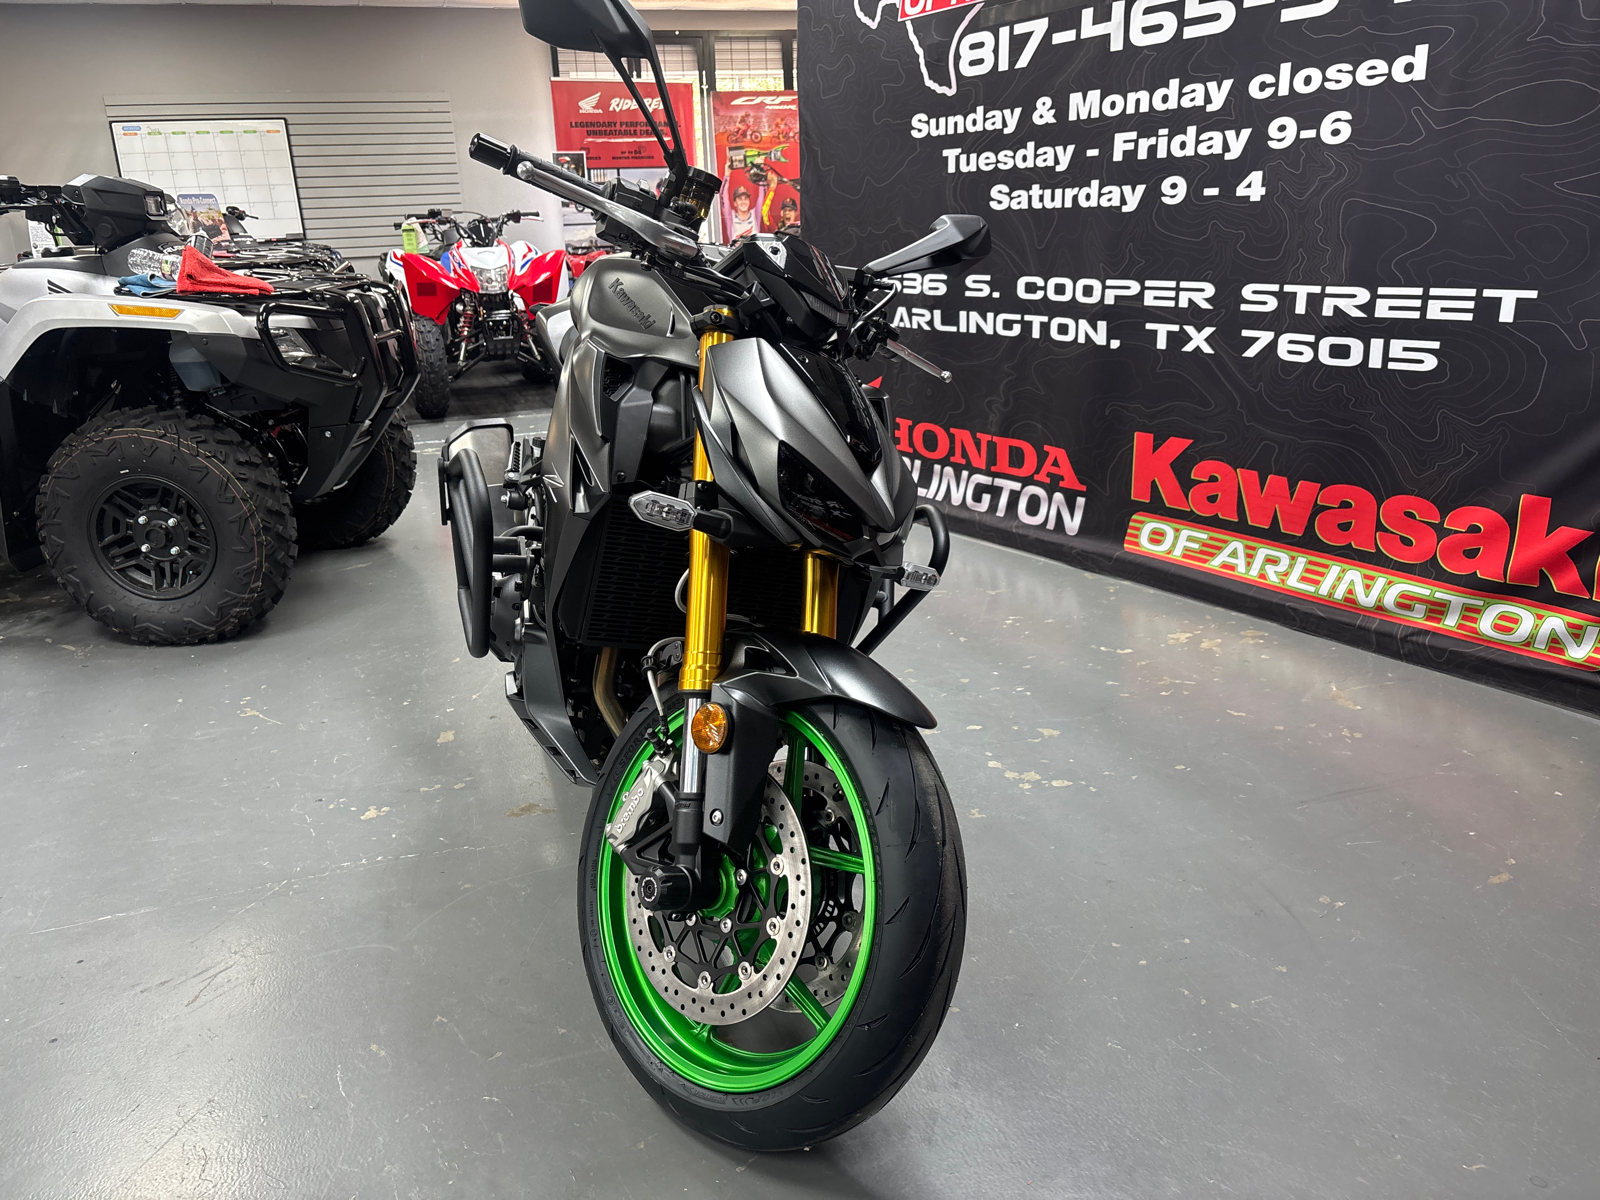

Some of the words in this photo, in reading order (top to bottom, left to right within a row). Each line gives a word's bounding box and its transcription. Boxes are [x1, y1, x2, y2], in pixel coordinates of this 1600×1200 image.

[730, 95, 798, 106] CRF
[911, 106, 1022, 138] Sunday
[1032, 96, 1057, 125] &
[1069, 78, 1234, 121] Monday
[1248, 44, 1429, 100] closed
[570, 121, 617, 129] LEGENDARY
[586, 129, 638, 137] UNBEATABLE
[640, 129, 668, 137] DEAS.
[942, 141, 1075, 173] Tuesday
[1113, 125, 1252, 162] Friday
[1267, 111, 1352, 149] 9-6
[989, 179, 1146, 212] Saturday
[1161, 176, 1187, 205] 9
[1236, 171, 1266, 201] 4
[608, 277, 656, 330] Kawasaki
[965, 275, 1000, 298] S.
[1017, 276, 1215, 309] COOPER
[1240, 284, 1538, 323] STREET
[893, 306, 1120, 349] ARLINGTON,
[1145, 322, 1216, 354] TX
[1240, 329, 1440, 372] 76015
[902, 456, 1086, 536] LINGTON
[1131, 431, 1600, 601] Kawasak
[1139, 521, 1208, 558] OF
[1210, 540, 1600, 659] ARLINGTON
[615, 787, 644, 834] brembo
